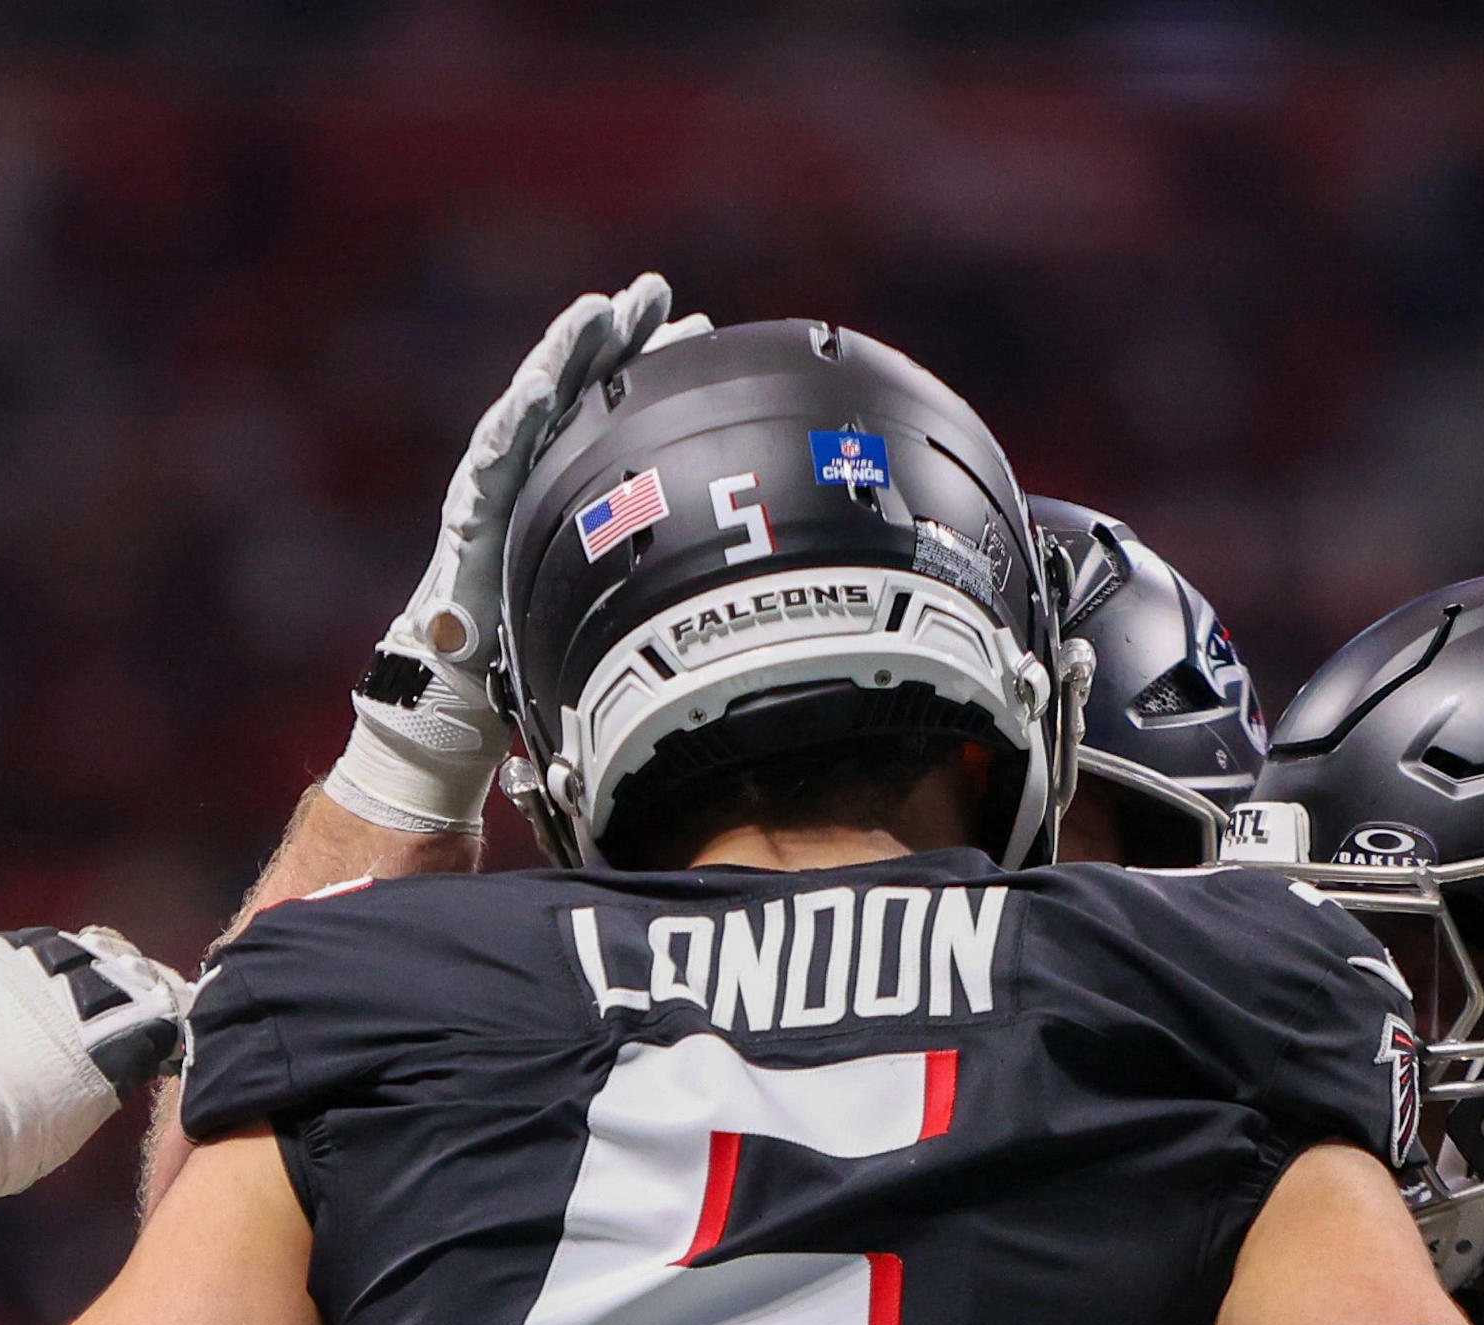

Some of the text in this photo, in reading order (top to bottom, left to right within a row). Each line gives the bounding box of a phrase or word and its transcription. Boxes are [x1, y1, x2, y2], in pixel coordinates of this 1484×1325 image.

[708, 472, 779, 567] 5
[670, 585, 870, 644] FALCONS
[1224, 809, 1265, 837] ATL
[571, 886, 1009, 1032] LONDON
